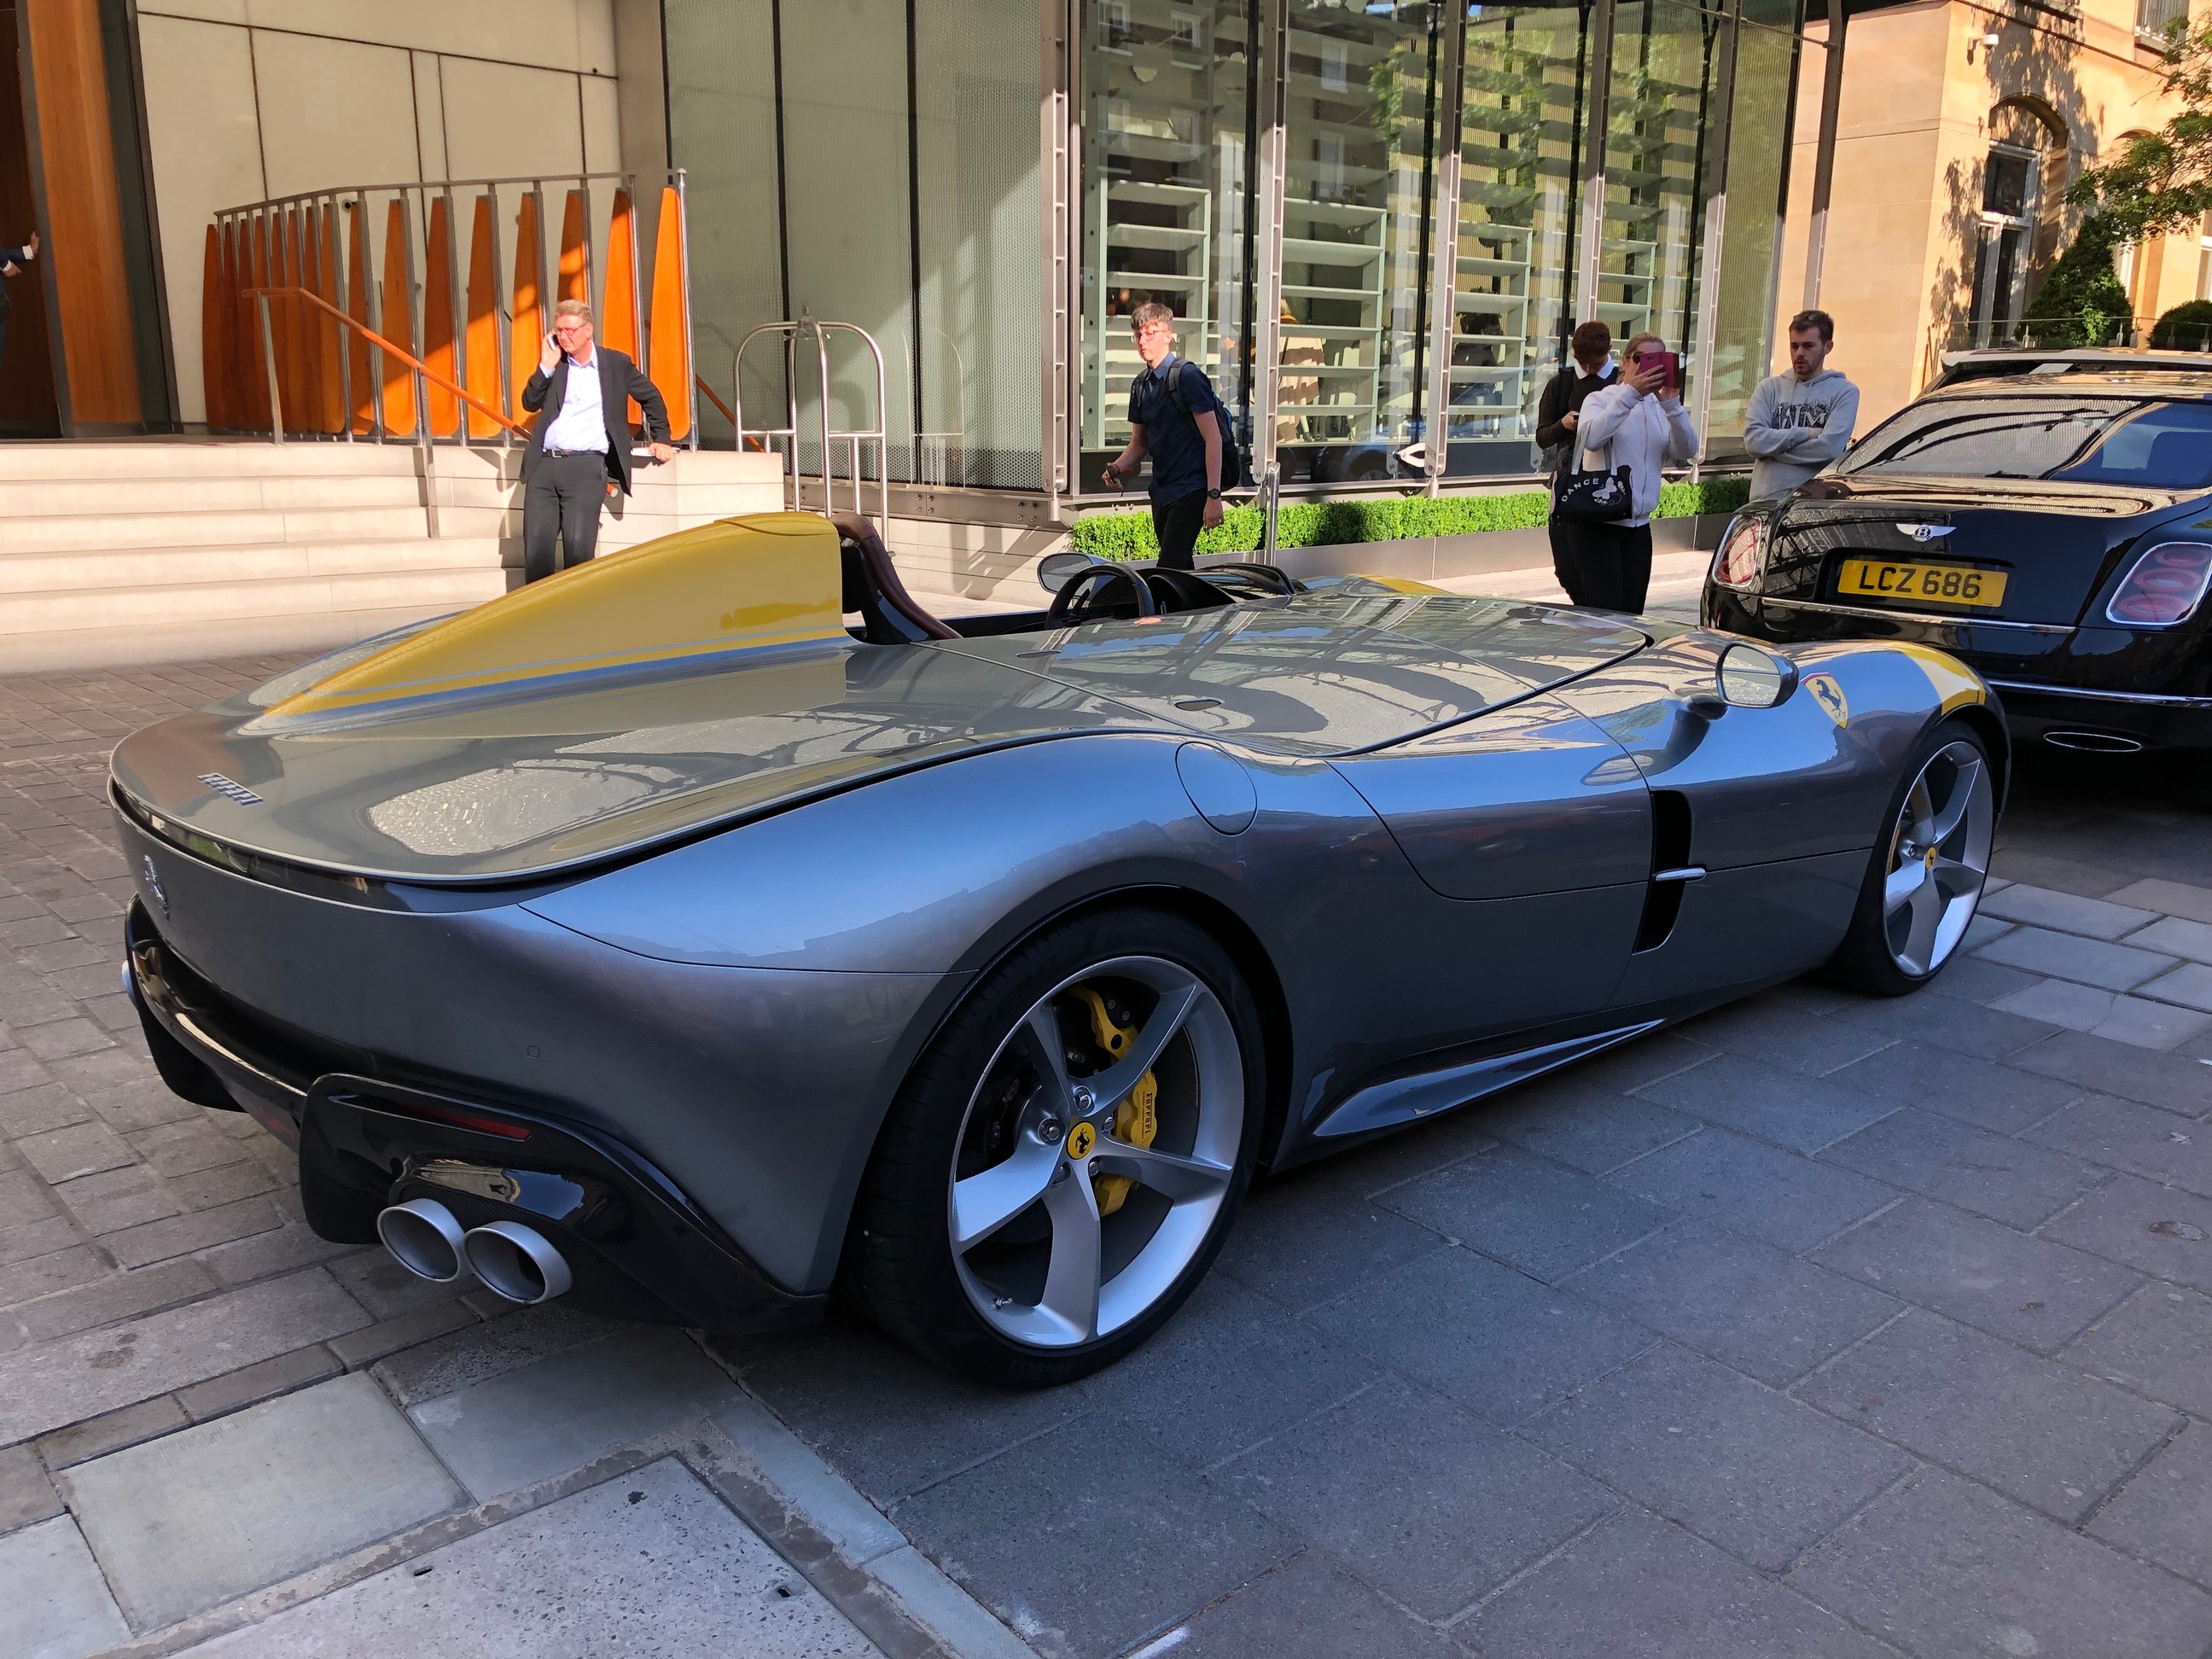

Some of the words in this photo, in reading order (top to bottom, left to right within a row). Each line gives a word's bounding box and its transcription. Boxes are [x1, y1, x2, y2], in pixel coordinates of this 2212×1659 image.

[1562, 478, 1599, 503] DANCE
[1918, 527, 1929, 538] B
[1859, 565, 1917, 593] LCZ
[1922, 570, 1983, 599] 686
